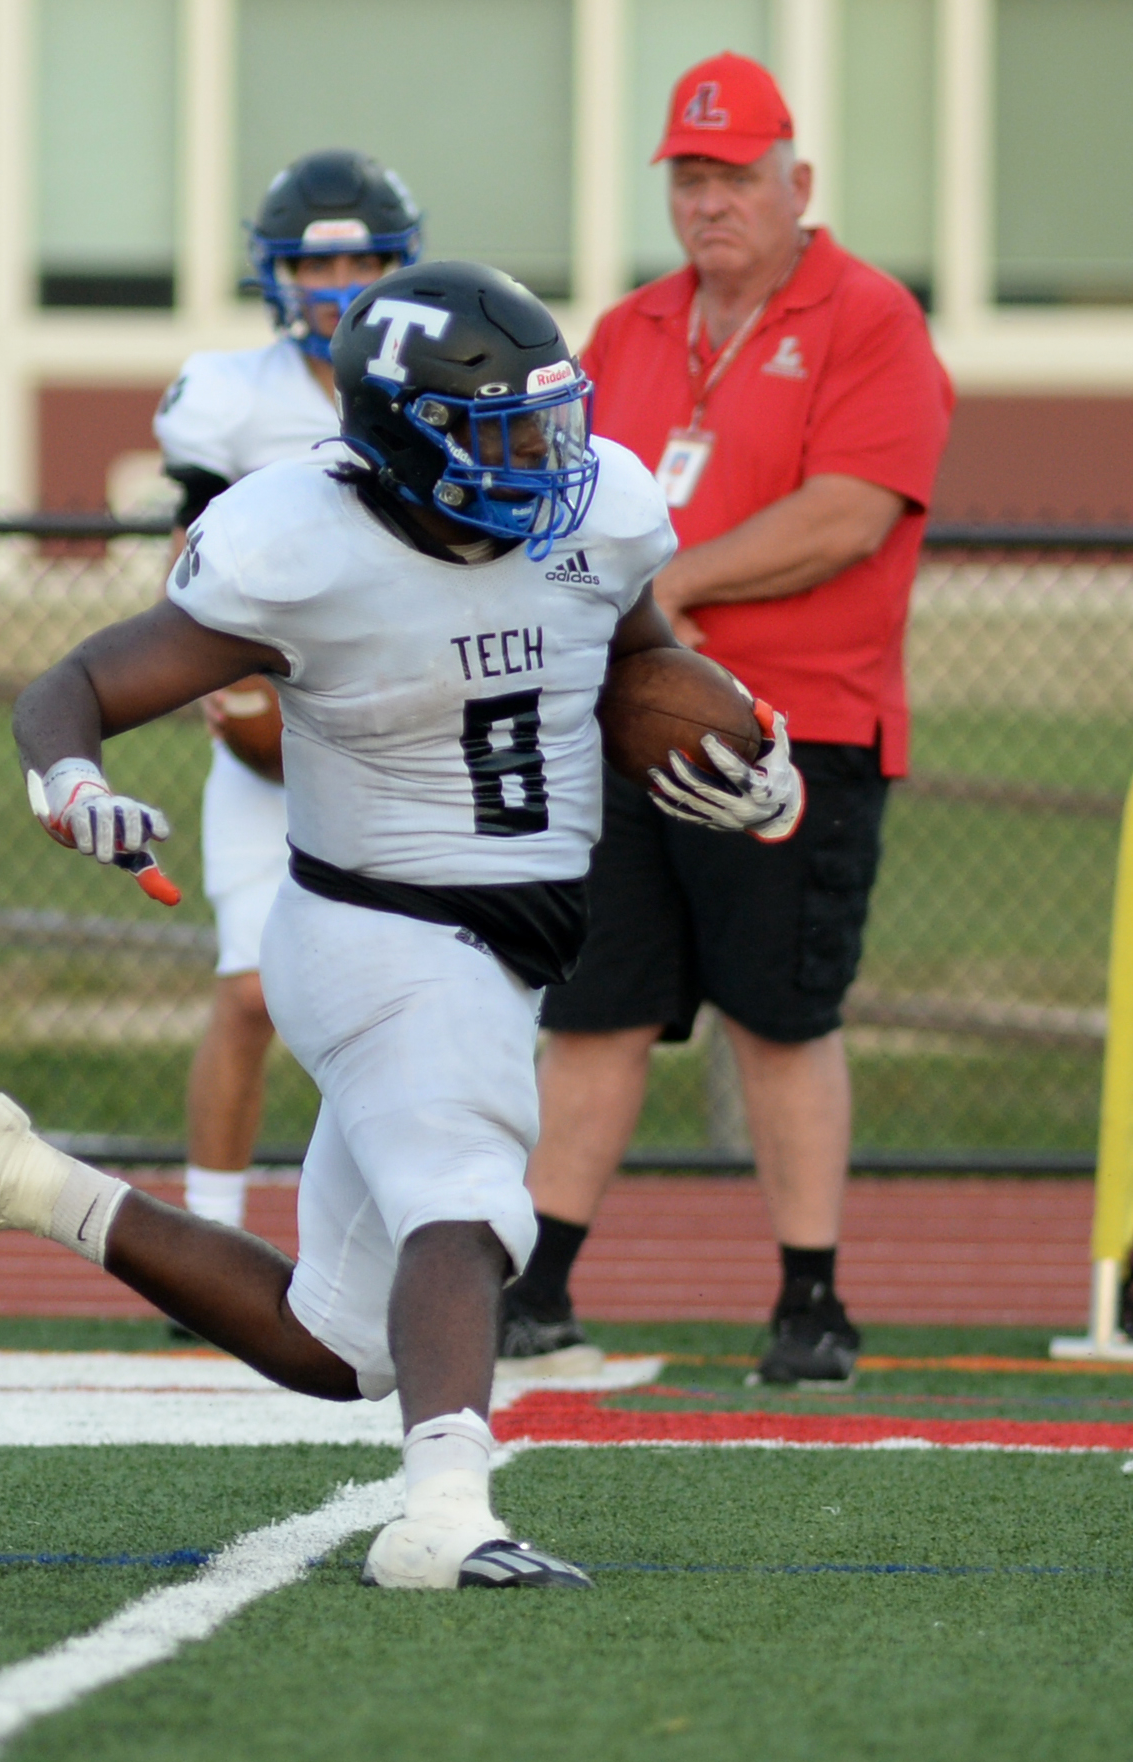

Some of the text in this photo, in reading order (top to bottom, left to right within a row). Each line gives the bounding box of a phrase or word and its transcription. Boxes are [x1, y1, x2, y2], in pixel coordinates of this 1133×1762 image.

[689, 80, 729, 129] L
[366, 298, 451, 383] T
[536, 365, 572, 386] Riddell
[545, 568, 600, 586] adidas
[451, 626, 544, 681] TECH
[460, 687, 549, 836] 8
